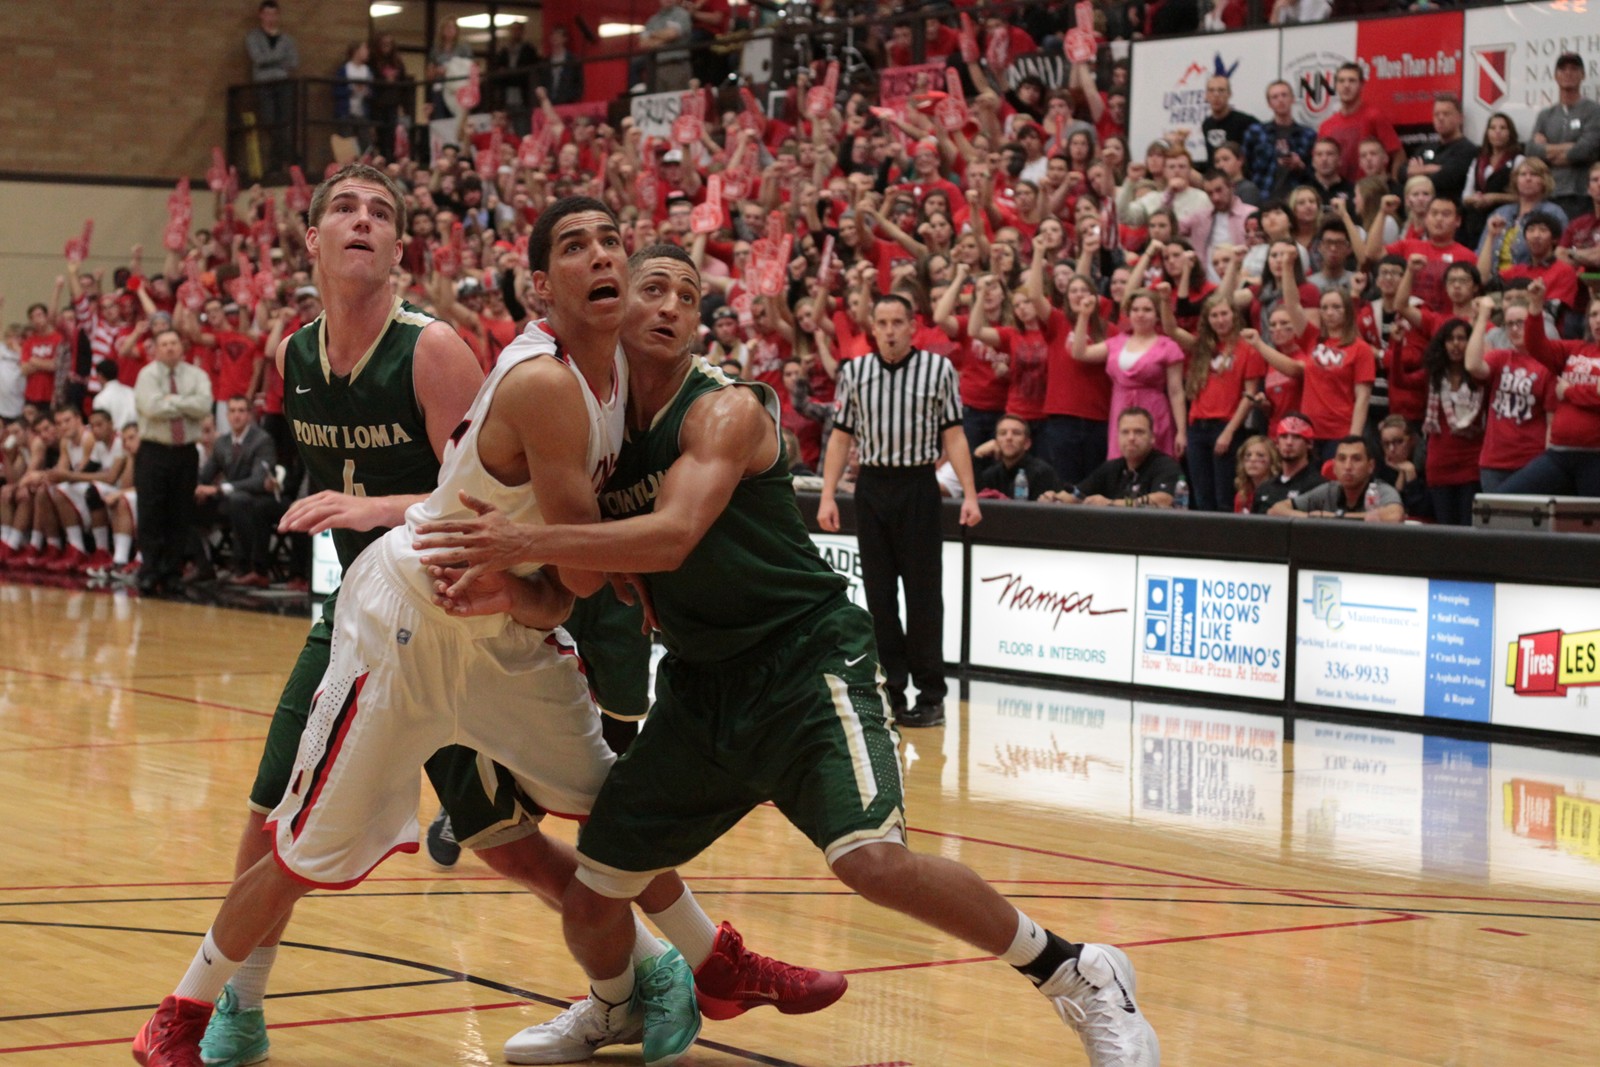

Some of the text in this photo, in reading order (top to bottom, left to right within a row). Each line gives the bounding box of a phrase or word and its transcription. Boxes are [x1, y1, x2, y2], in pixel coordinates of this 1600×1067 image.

[293, 419, 413, 449] POINT LOMA
[981, 573, 1128, 631] Nampa
[1202, 579, 1272, 603] NOBODY
[1201, 600, 1260, 624] KNOWS
[1349, 611, 1410, 626] Maintenance
[1182, 612, 1194, 656] PIZZA
[1200, 621, 1232, 641] LIKE
[999, 640, 1106, 664] FLOOR & INTERIORS
[1200, 641, 1281, 669] DOMINO'S
[1520, 638, 1555, 690] Tires
[1566, 641, 1597, 675] LES
[1142, 656, 1161, 670] How
[1166, 657, 1181, 672] You
[1185, 660, 1204, 675] Like
[1207, 661, 1232, 678] Pizza
[1236, 664, 1246, 680] At
[1324, 660, 1390, 685] 336-9933
